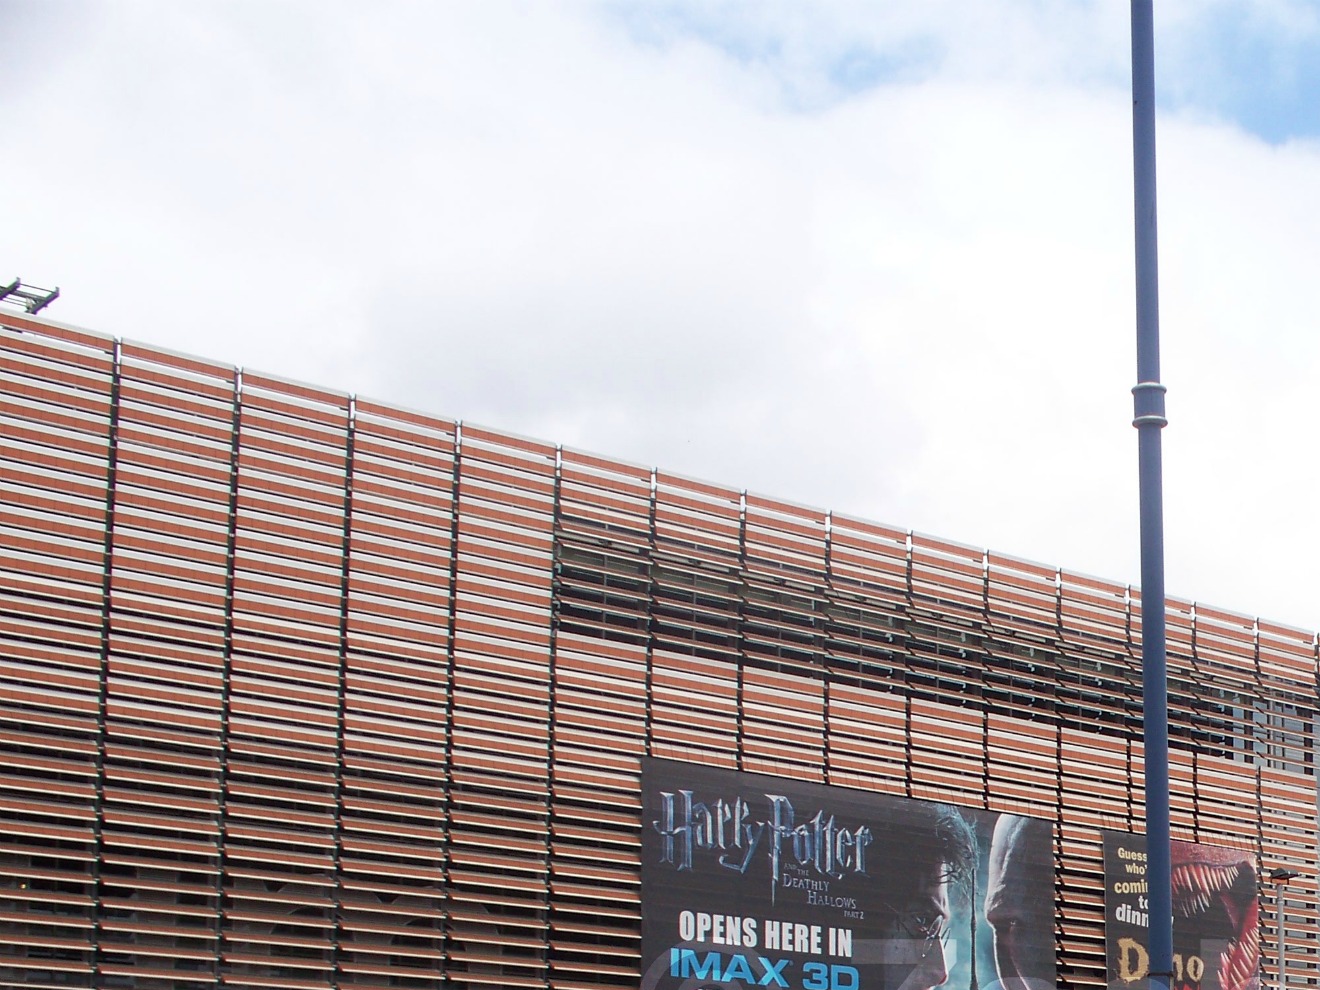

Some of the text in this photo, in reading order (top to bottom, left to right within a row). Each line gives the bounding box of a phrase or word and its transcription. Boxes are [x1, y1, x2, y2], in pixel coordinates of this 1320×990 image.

[653, 789, 873, 907] Harry Potter
[1117, 847, 1148, 862] Guess
[1125, 862, 1148, 875] who'
[782, 873, 830, 892] DEATHLY
[1114, 878, 1149, 894] comi
[807, 890, 857, 910] HALLOWS
[679, 911, 853, 958] OPENS HERE IN
[670, 947, 791, 988] IMAX
[1116, 937, 1204, 984] Dno
